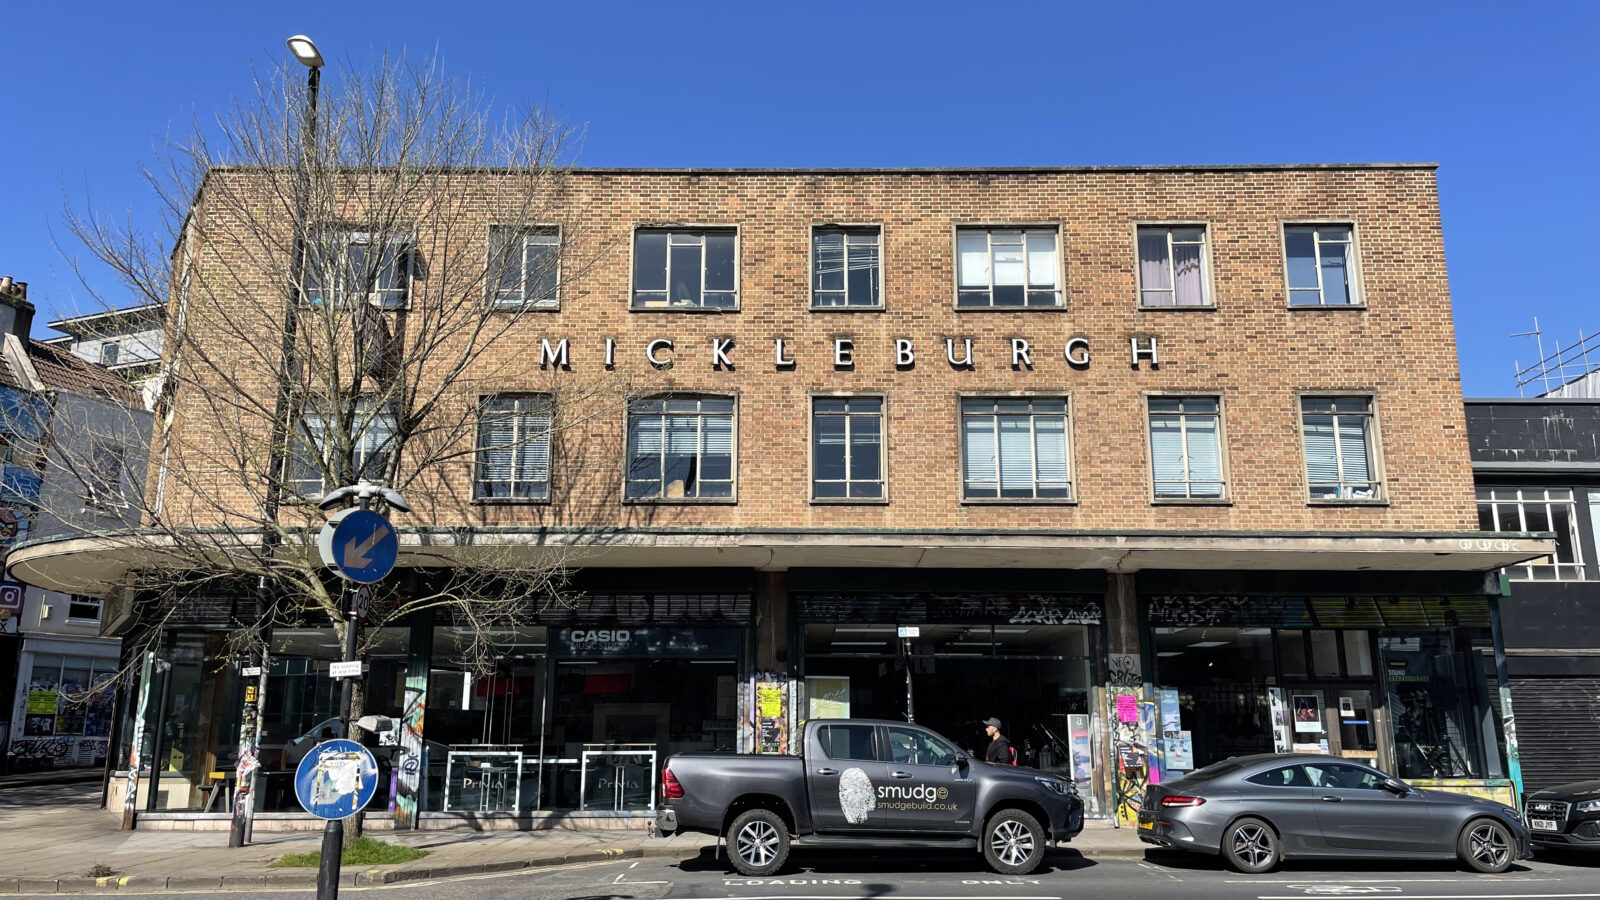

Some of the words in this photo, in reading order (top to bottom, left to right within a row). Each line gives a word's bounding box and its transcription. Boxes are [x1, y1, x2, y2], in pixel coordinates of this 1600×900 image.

[540, 337, 1161, 371] MICKLEBURGH
[358, 594, 369, 611] 20
[571, 630, 631, 642] CASIO
[462, 777, 504, 789] Privia
[598, 778, 639, 789] Privia
[877, 783, 949, 803] smudge
[877, 801, 958, 811] smudgebuild.co.uk
